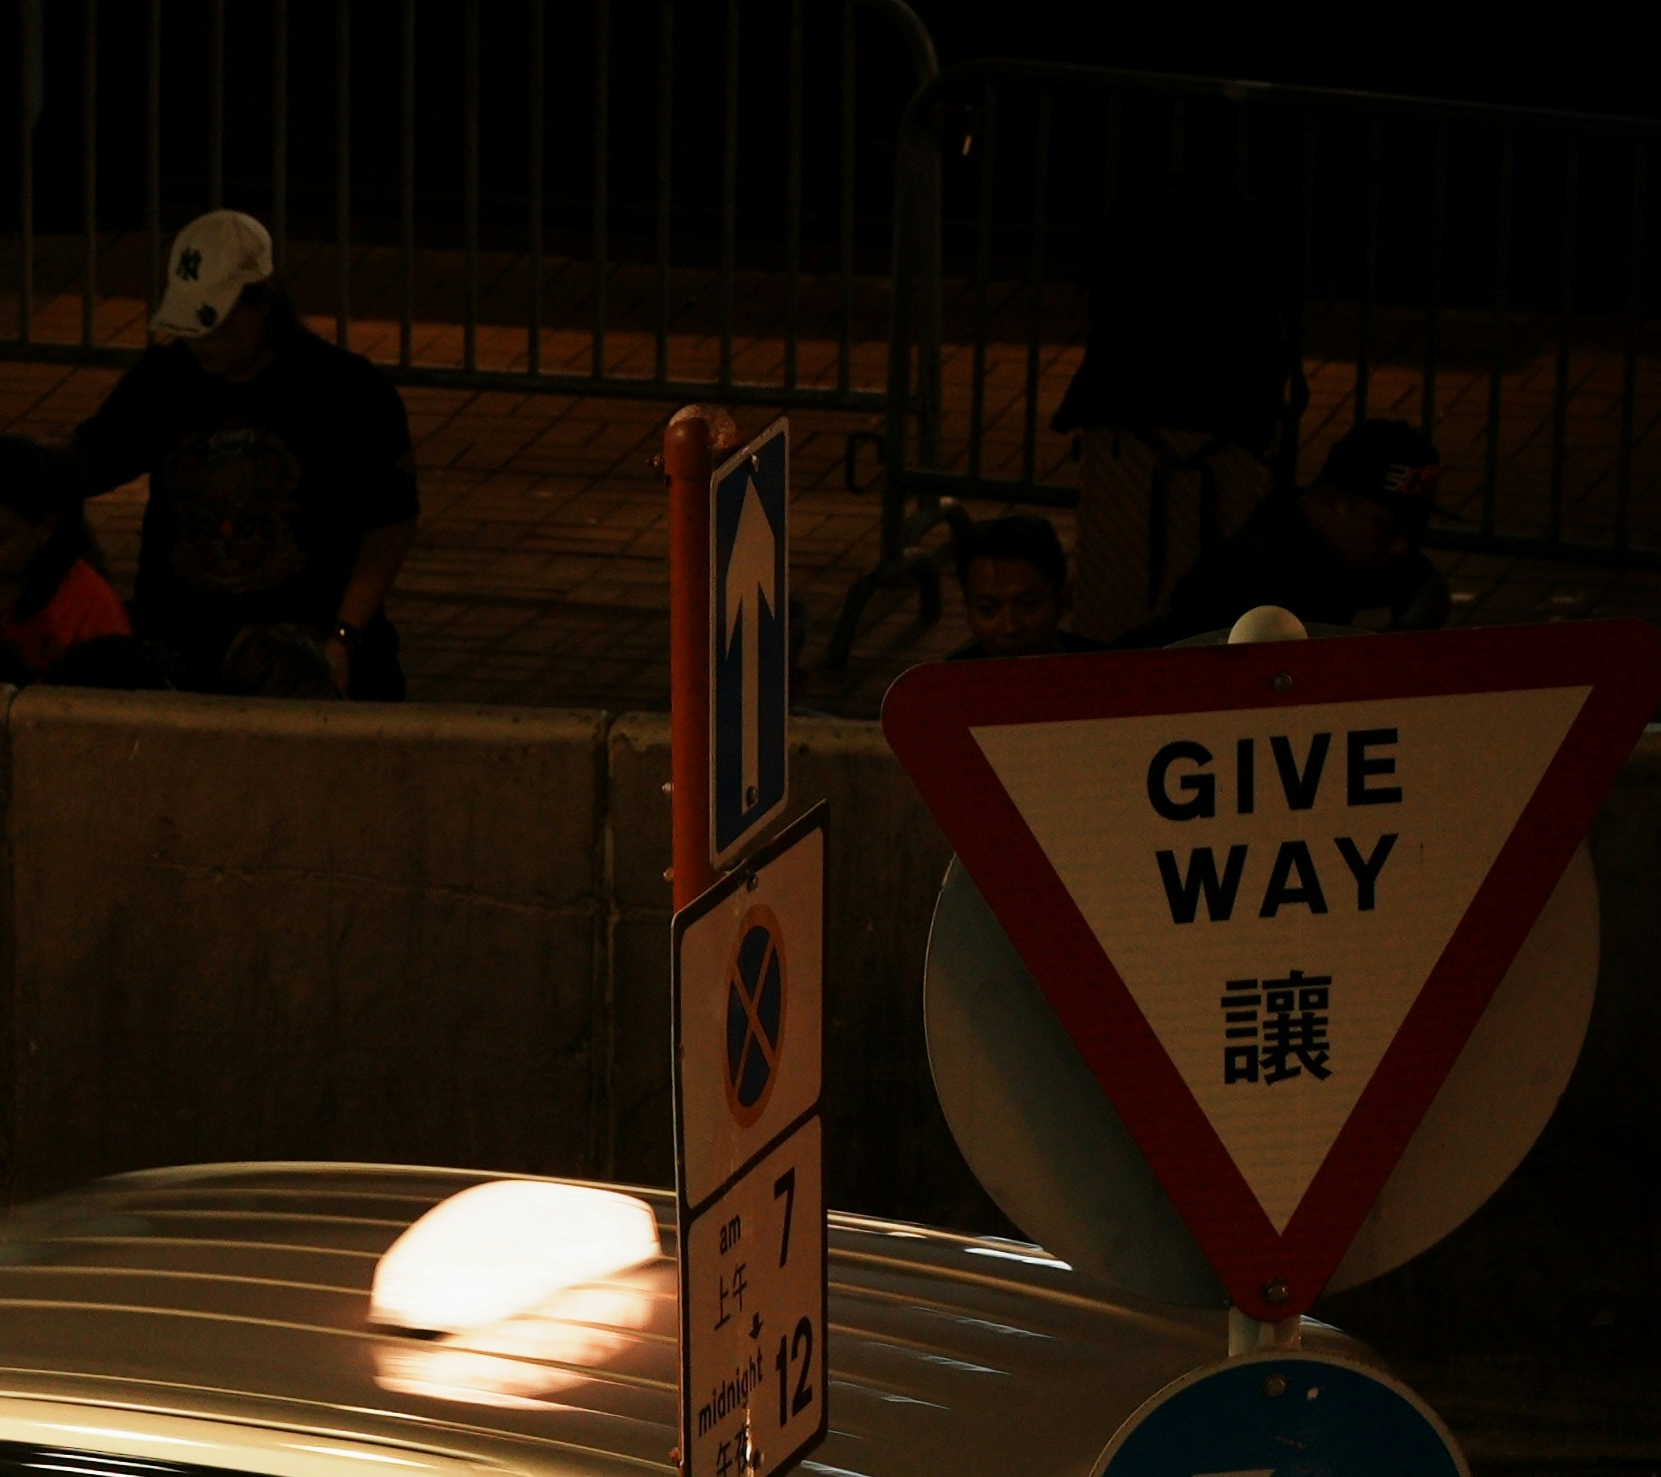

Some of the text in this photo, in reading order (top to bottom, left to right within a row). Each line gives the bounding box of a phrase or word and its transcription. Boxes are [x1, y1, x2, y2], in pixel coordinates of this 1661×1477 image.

[1146, 727, 1403, 822] GIVE
[1154, 832, 1399, 925] WAY
[1221, 969, 1333, 1087] 讓
[719, 1213, 742, 1256] am
[774, 1166, 796, 1269] 7
[713, 1262, 749, 1332] 上午
[698, 1346, 765, 1438] midnight
[774, 1315, 814, 1429] 12
